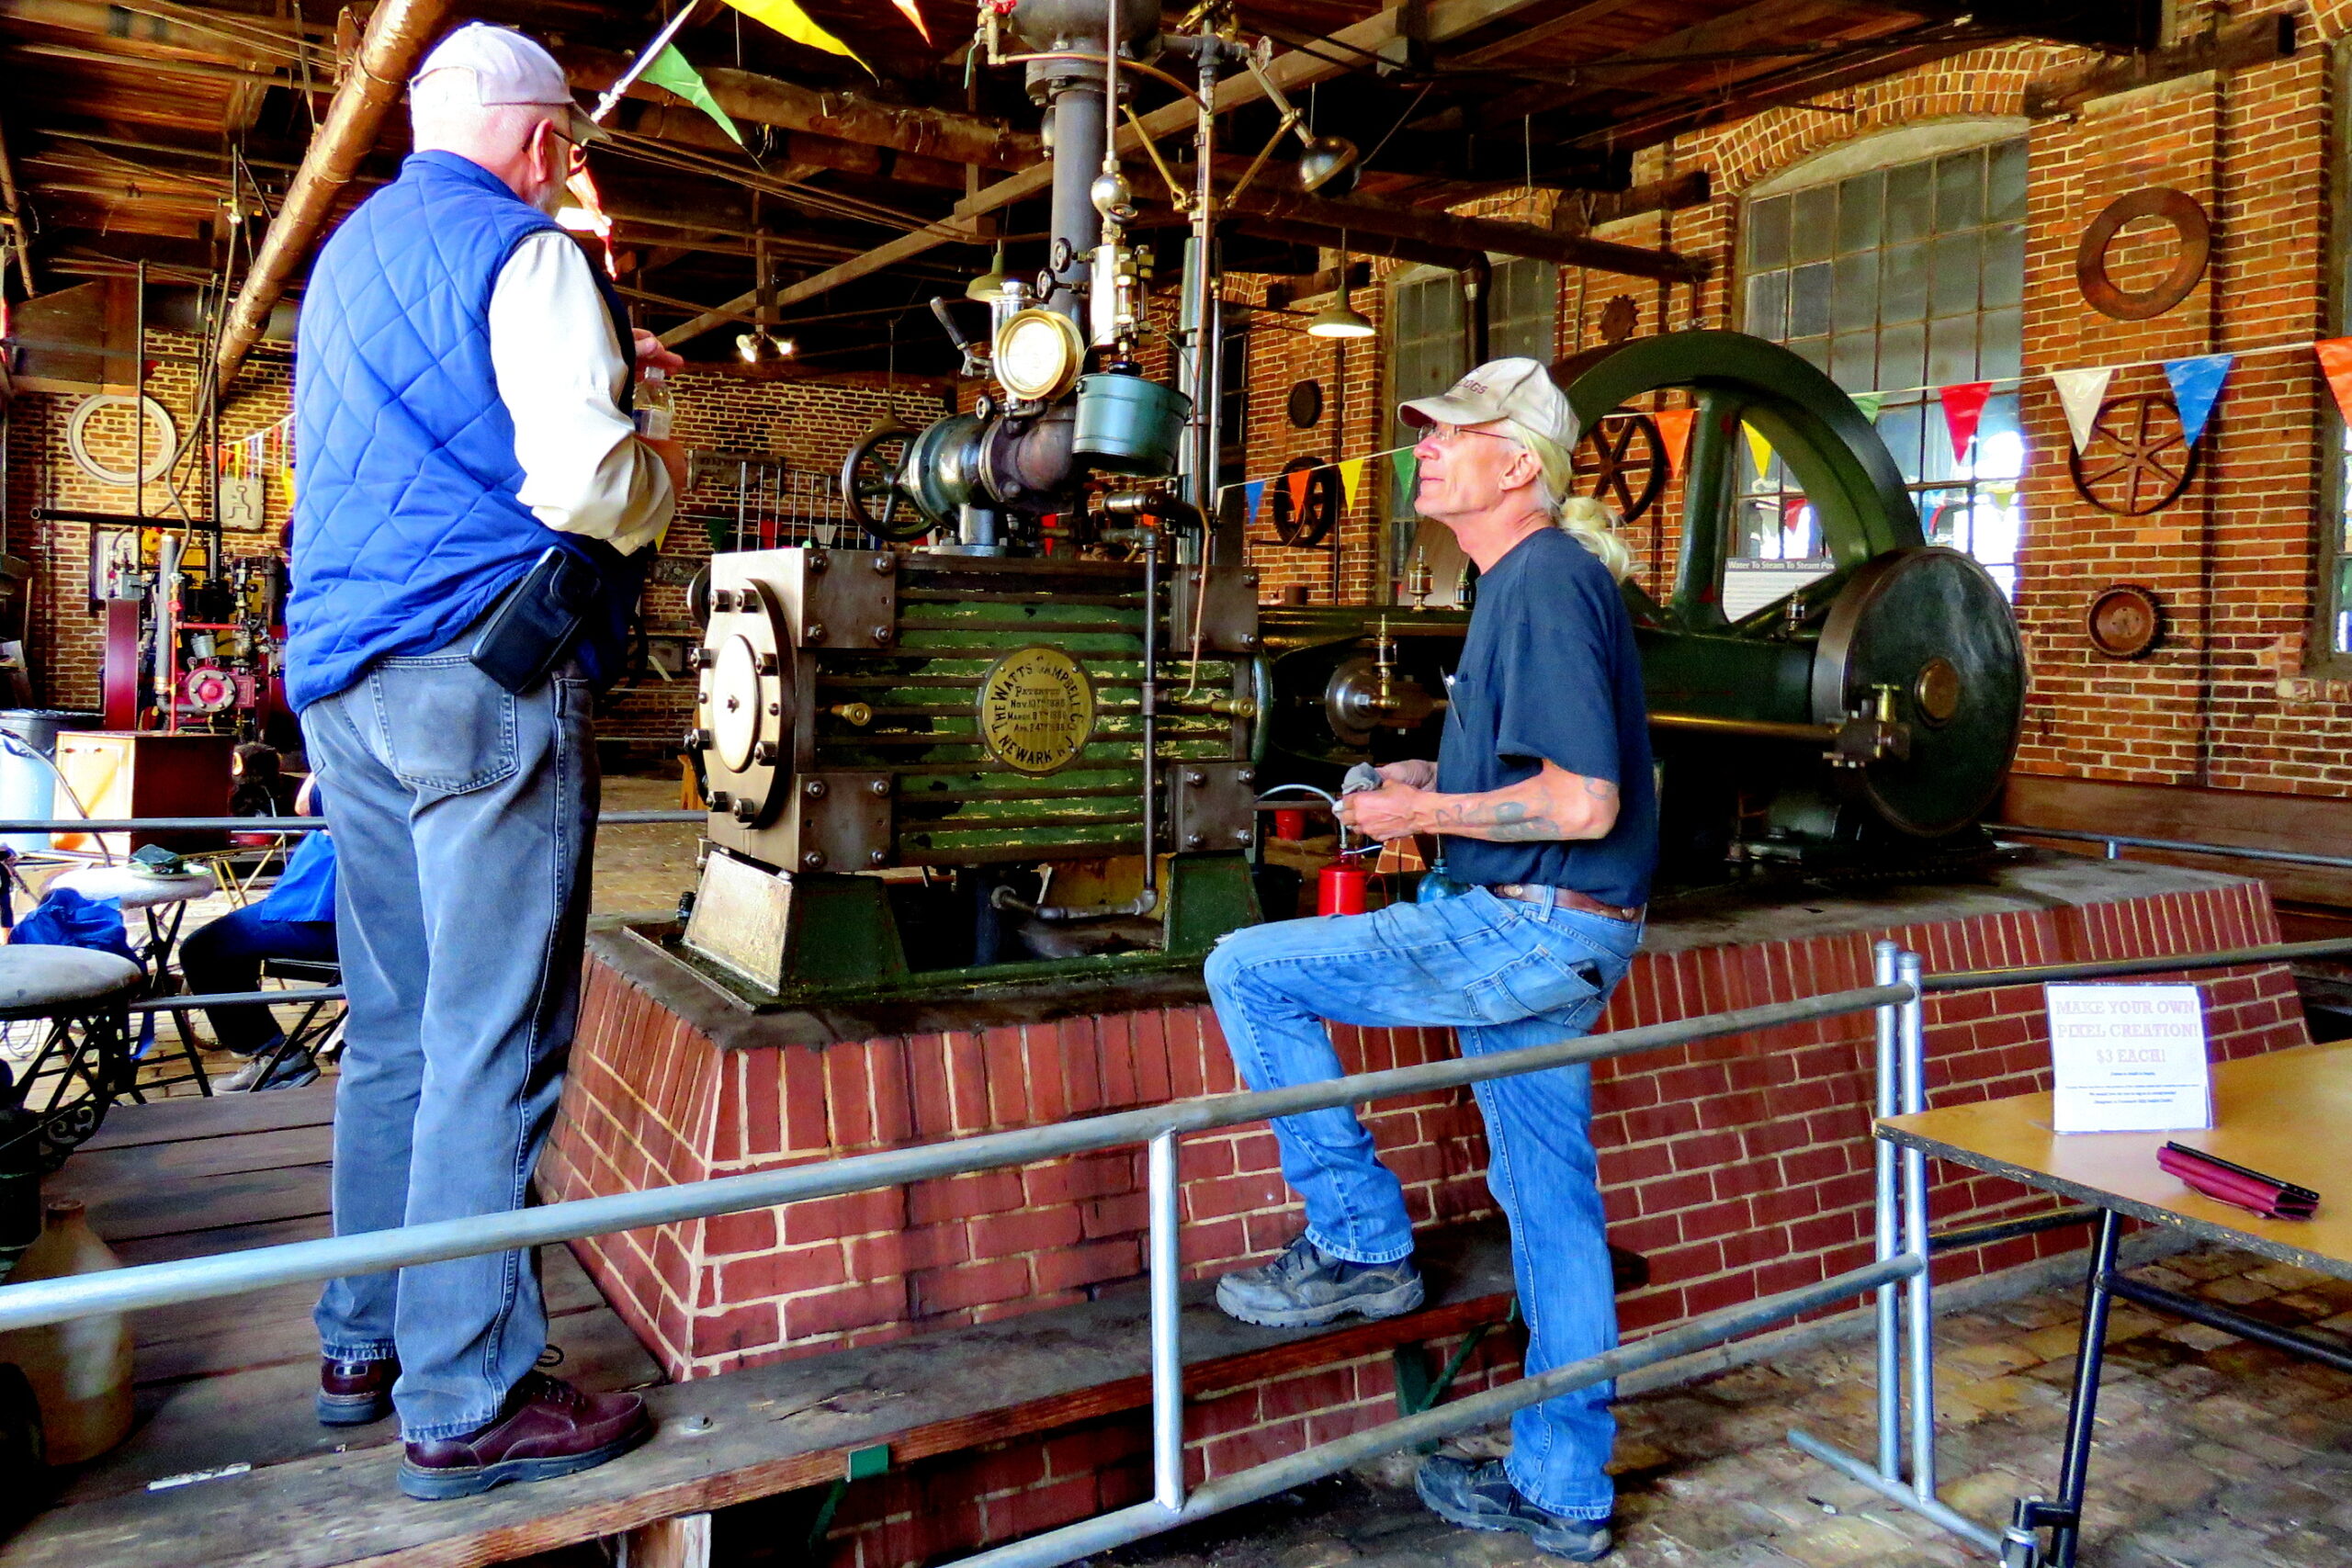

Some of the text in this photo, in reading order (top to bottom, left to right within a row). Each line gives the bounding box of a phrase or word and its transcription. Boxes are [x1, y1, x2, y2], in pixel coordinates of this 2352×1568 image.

[1727, 560, 1750, 570] Water
[1751, 560, 1760, 570] To
[1761, 560, 1784, 570] Steam
[1786, 560, 1794, 570] To
[1796, 560, 1819, 570] Steam
[990, 662, 1033, 701] WATTS
[991, 705, 1008, 734] THE
[998, 734, 1053, 765] NEWARK
[2055, 1000, 2195, 1015] MAKE YOUR OWN
[2109, 1023, 2199, 1038] CREATION!
[2097, 1048, 2166, 1065] $3 EACH!
